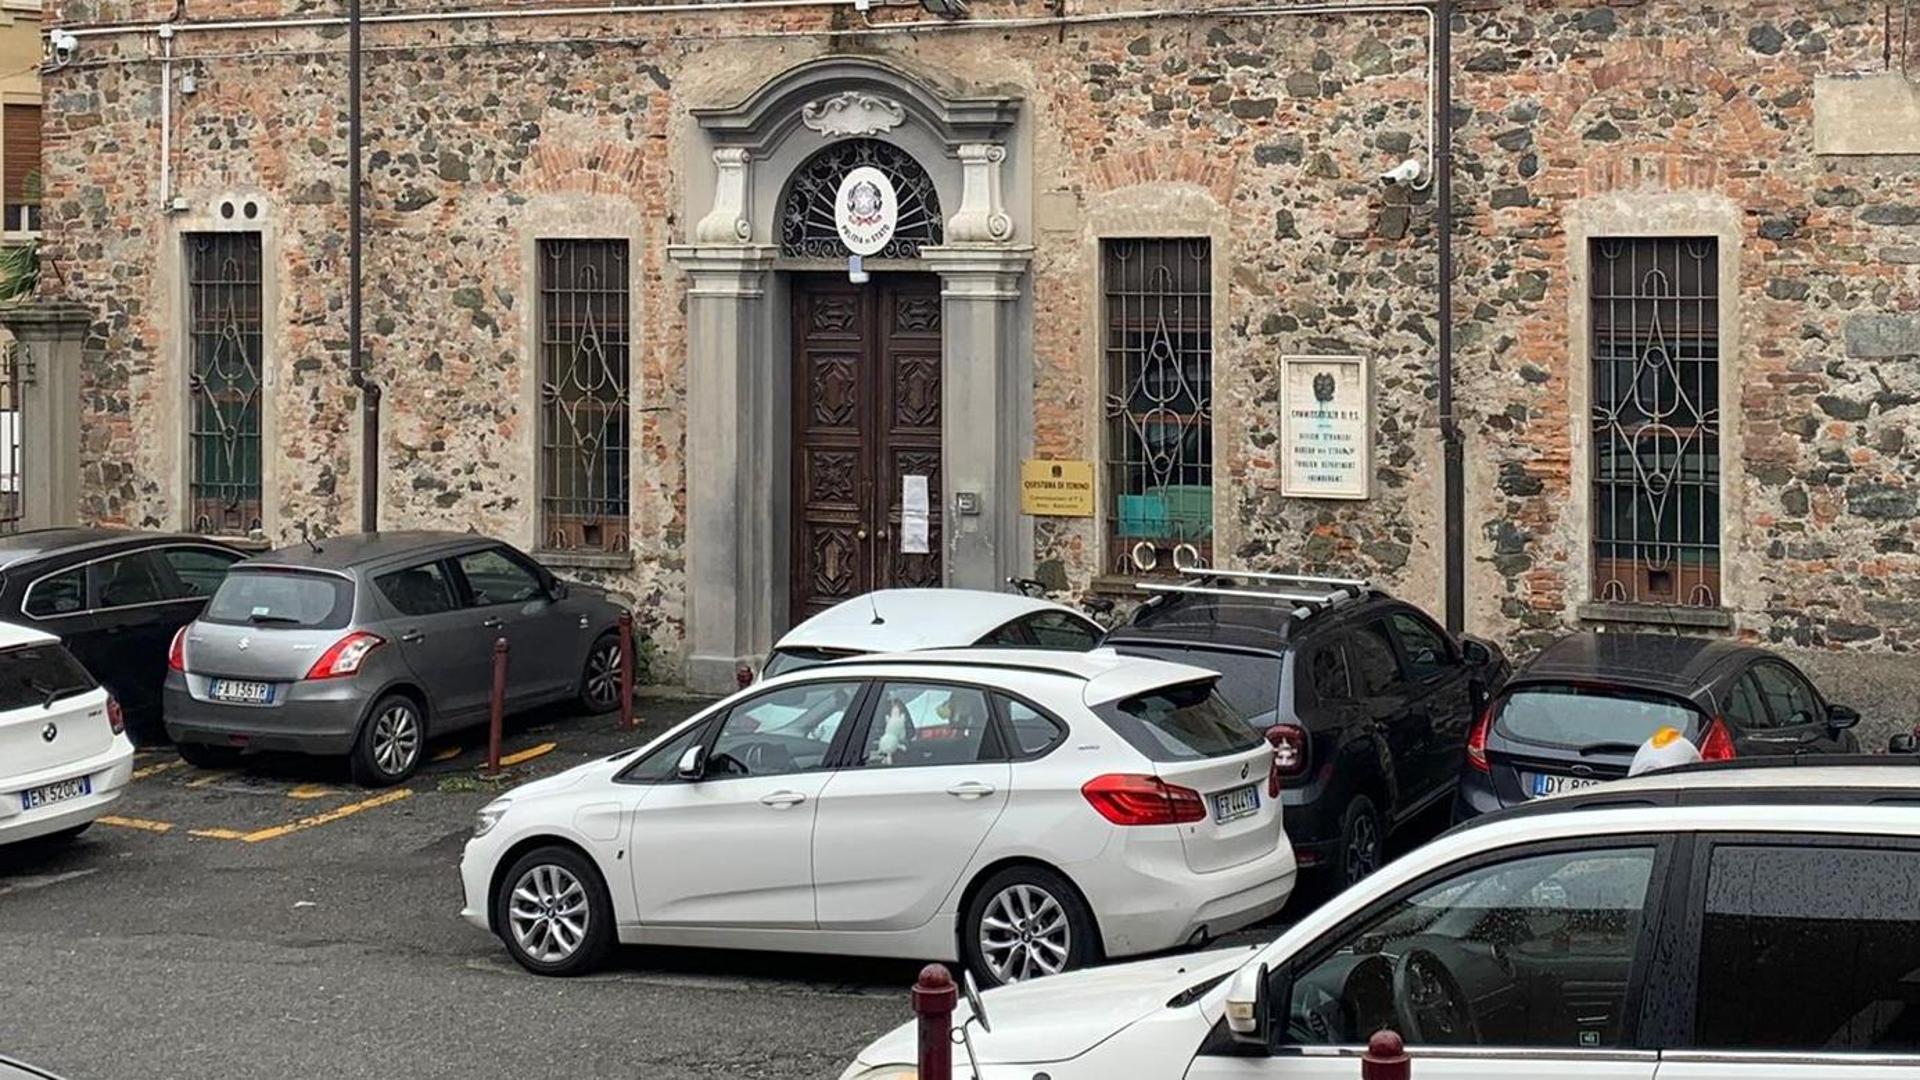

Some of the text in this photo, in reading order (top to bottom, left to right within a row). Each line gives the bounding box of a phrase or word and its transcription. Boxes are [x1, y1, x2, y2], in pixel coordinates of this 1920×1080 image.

[840, 225, 863, 244] POLIZIA
[871, 224, 890, 242] STATO
[1024, 481, 1057, 490] QUESTURA
[1066, 482, 1090, 490] TORINO
[1546, 777, 1565, 793] DY
[31, 788, 47, 806] EN
